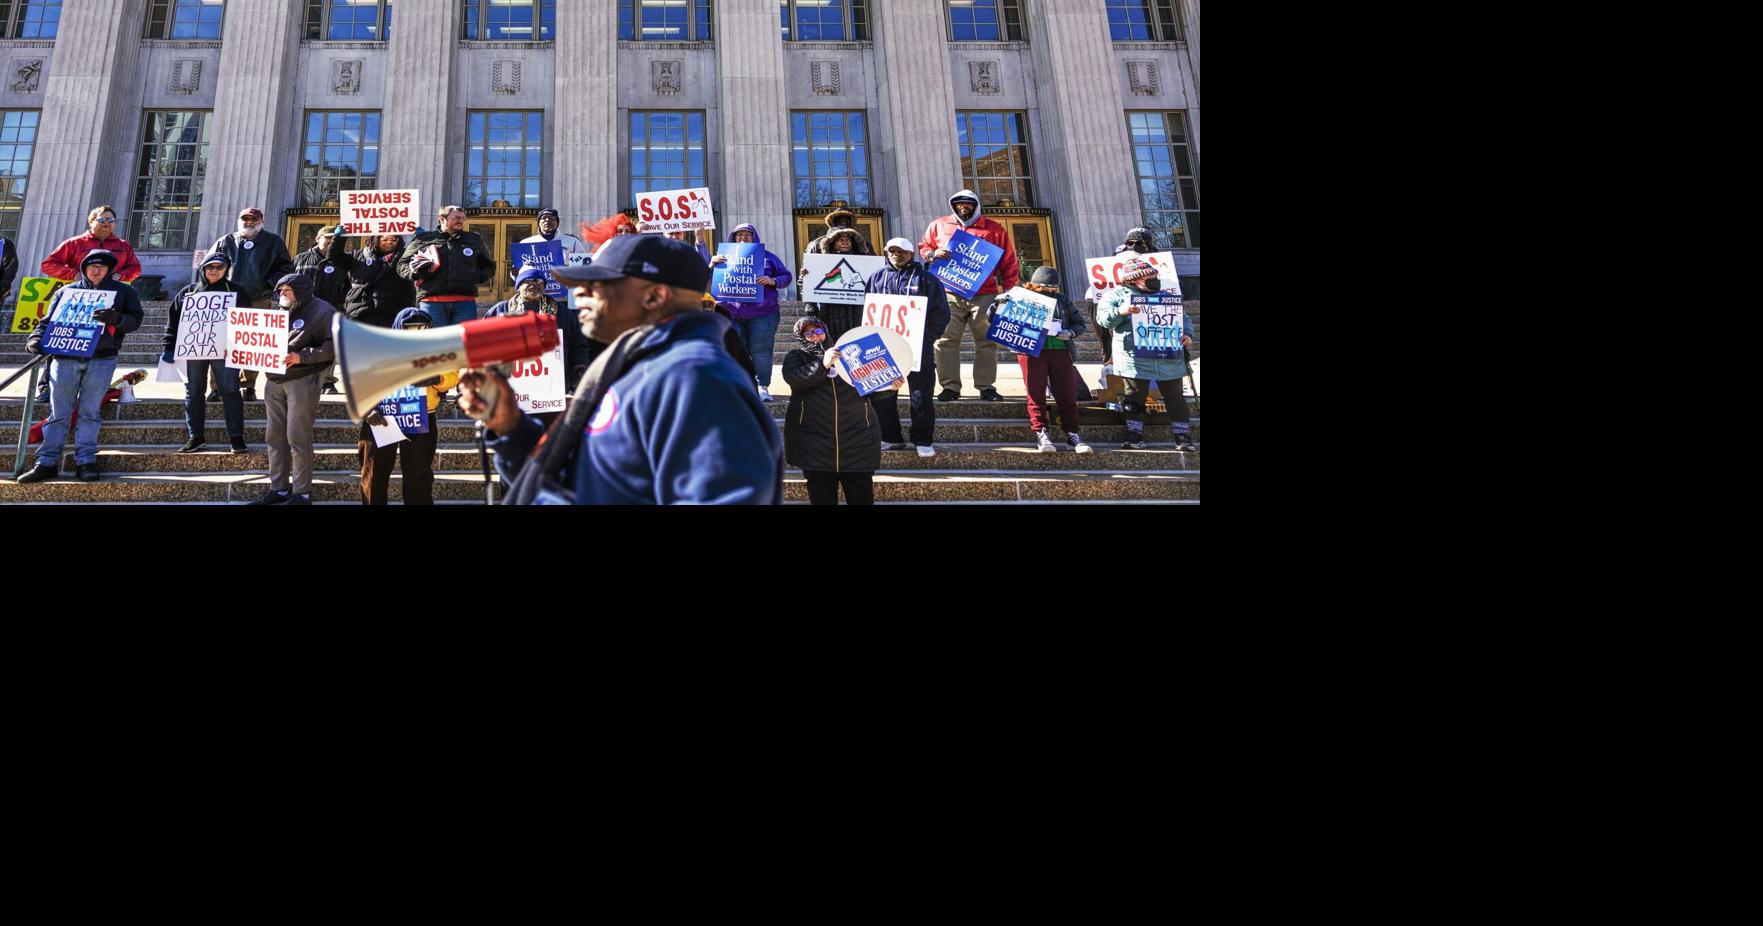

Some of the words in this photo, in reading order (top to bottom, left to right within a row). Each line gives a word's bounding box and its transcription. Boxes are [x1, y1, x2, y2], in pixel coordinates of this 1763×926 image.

[348, 192, 412, 204] SERVICE
[352, 207, 408, 218] POSTAL
[640, 195, 697, 222] S.O.S.
[344, 222, 372, 233] THE
[378, 221, 416, 233] SAVE
[531, 244, 536, 255] I
[735, 245, 739, 255] I
[970, 239, 978, 250] I
[522, 252, 554, 263] Stand
[956, 242, 989, 264] Stand
[733, 265, 753, 274] with
[947, 259, 981, 282] Postal
[961, 258, 981, 271] with
[723, 273, 757, 285] Postal
[937, 266, 972, 289] Workers
[718, 284, 757, 295] Workers
[71, 291, 107, 302] KEEP
[185, 295, 233, 310] DOGE
[181, 310, 227, 322] HANDS
[1140, 306, 1158, 314] AVE
[1164, 306, 1182, 314] THE
[230, 311, 258, 326] SAVE
[264, 313, 285, 328] THE
[1148, 314, 1176, 326] POST
[50, 326, 74, 336] JOBS
[189, 321, 219, 333] OFF
[996, 320, 1020, 333] JOBS
[1137, 326, 1182, 339] OFFICE
[184, 332, 217, 344] OUR
[235, 331, 278, 348] POSTAL
[992, 329, 1037, 350] JUSTICE
[44, 338, 91, 351] JUSTICE
[177, 345, 218, 357] DATA
[232, 349, 279, 368] SERVICE
[862, 366, 900, 390] JUSTICE!
[380, 404, 397, 414] OBS
[532, 400, 563, 409] SERVICE
[396, 414, 421, 427] TICE
